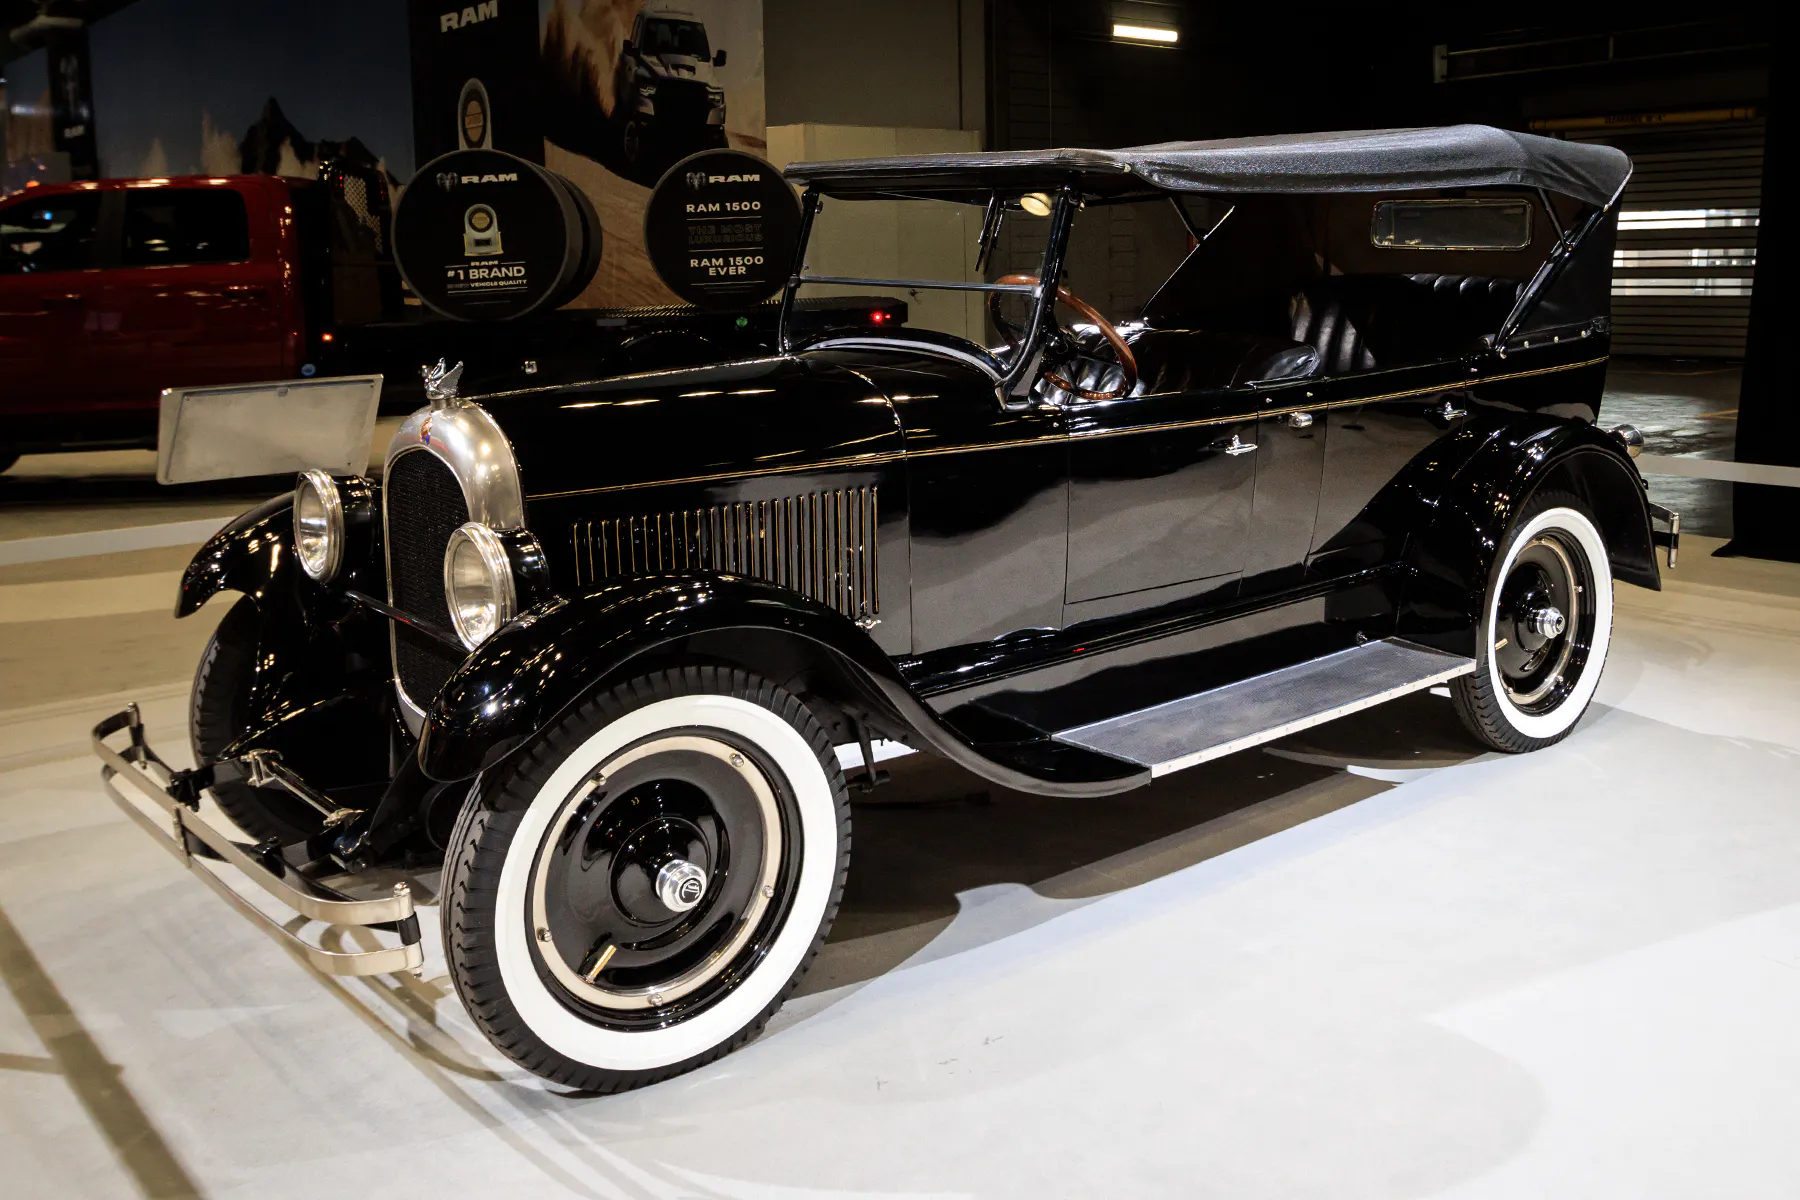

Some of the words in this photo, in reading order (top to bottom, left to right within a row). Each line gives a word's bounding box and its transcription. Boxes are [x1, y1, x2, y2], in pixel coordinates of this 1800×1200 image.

[440, 0, 498, 33] RAM
[461, 172, 518, 184] RAM
[708, 174, 761, 184] RAM
[686, 202, 721, 213] RAM
[725, 201, 761, 212] 1500
[688, 225, 716, 235] THE
[720, 224, 762, 234] MOST
[688, 233, 764, 245] LUXURIOUS
[690, 257, 724, 268] RAM
[728, 256, 764, 266] 1500
[469, 266, 526, 280] BRAND
[708, 266, 747, 276] EVER
[499, 279, 527, 287] QUALITY
